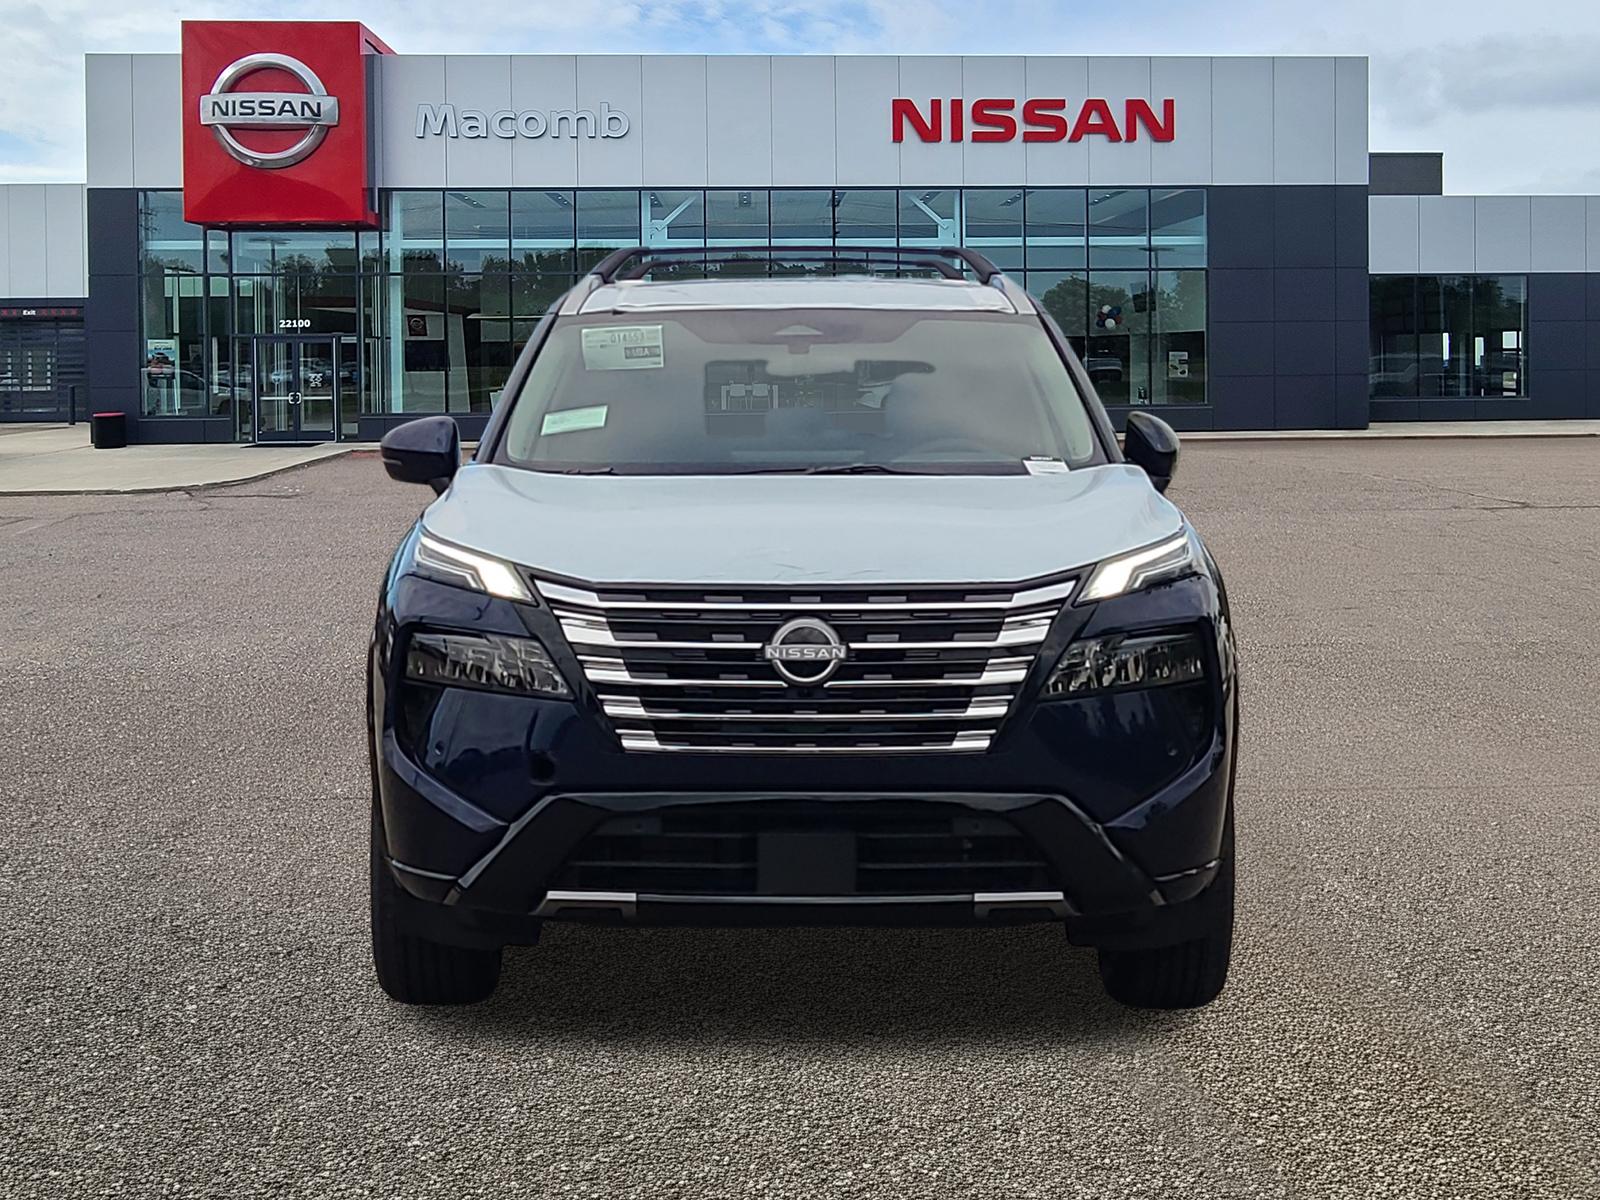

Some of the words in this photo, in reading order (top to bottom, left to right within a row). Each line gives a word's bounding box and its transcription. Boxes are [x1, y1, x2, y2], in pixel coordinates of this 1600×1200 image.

[212, 100, 322, 117] NISSAN
[415, 102, 630, 139] Macomb
[892, 98, 1175, 143] NISSAN
[279, 319, 311, 328] 22100
[766, 647, 845, 660] NISSAN
